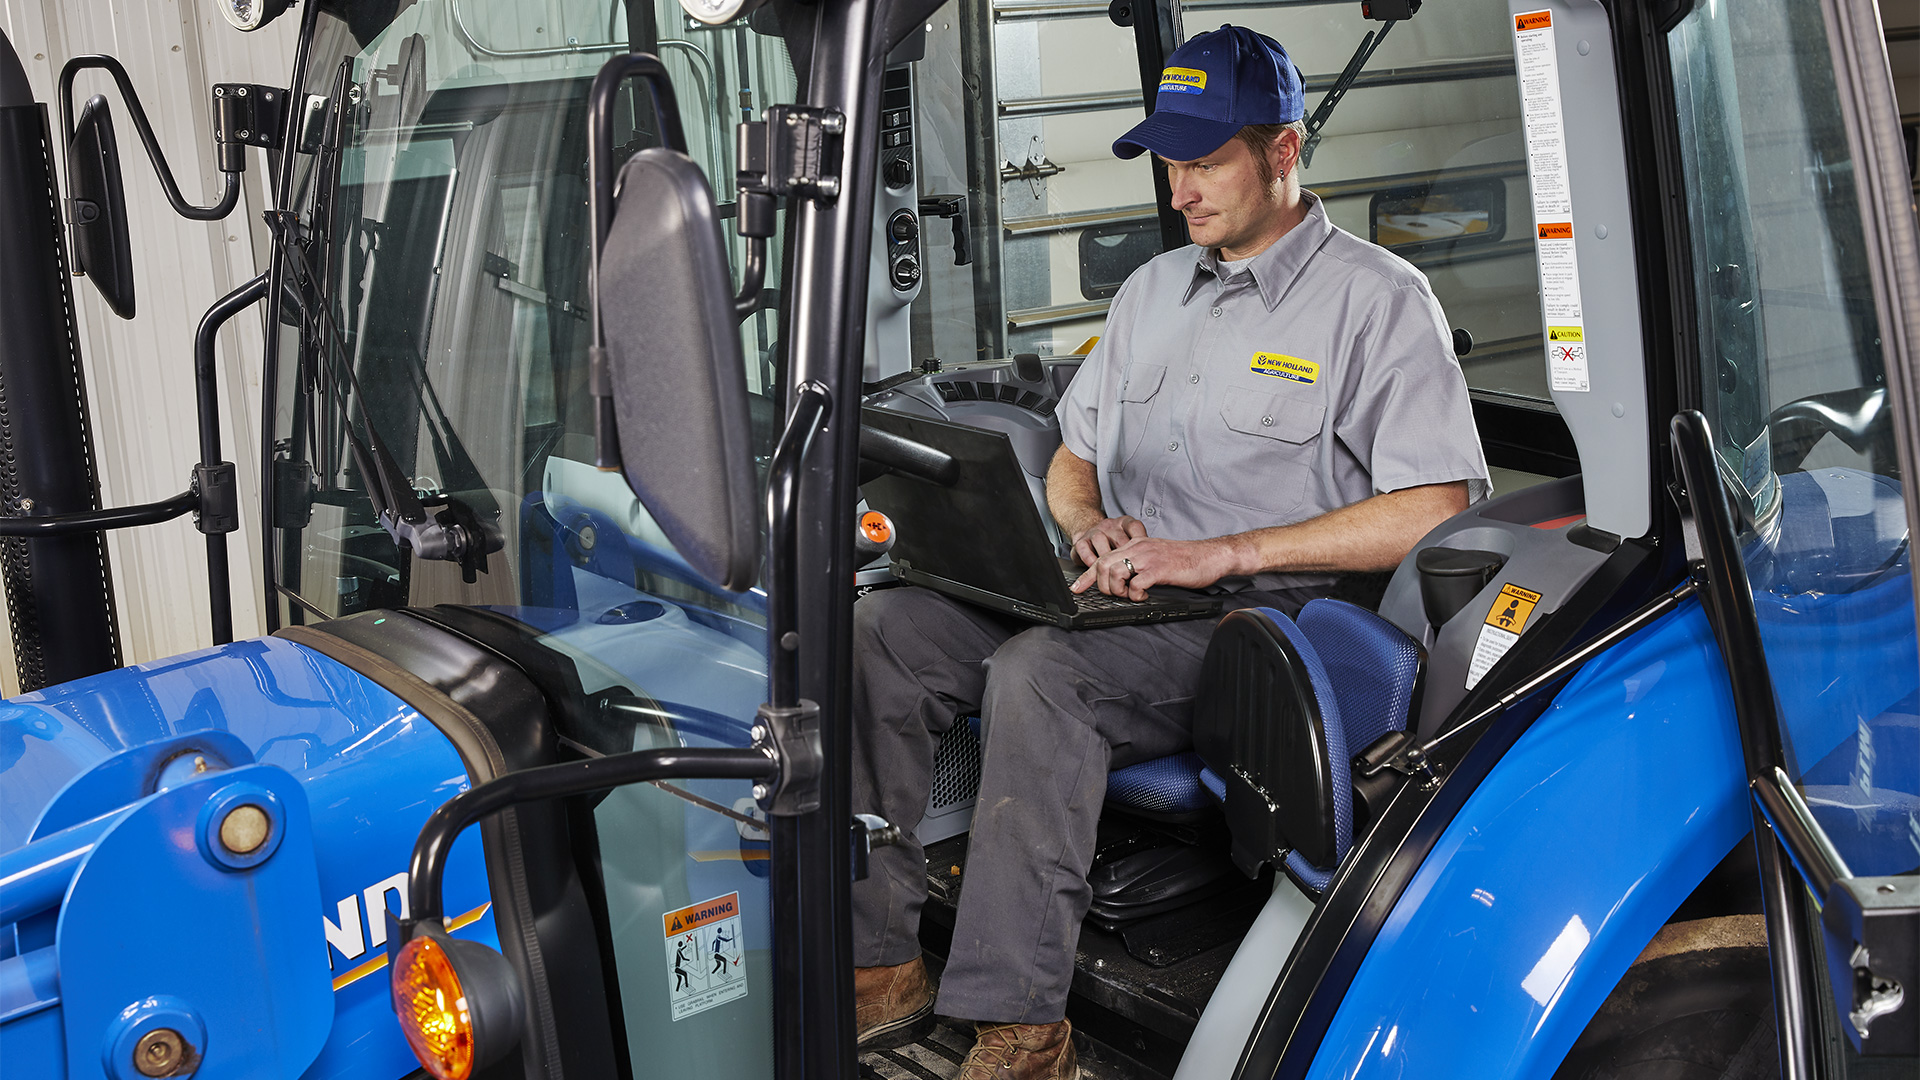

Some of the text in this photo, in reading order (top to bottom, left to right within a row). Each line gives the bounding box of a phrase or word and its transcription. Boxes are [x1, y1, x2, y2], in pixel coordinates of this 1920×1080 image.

[1523, 15, 1550, 25] WARNING
[1171, 74, 1200, 83] HOLLAND
[1282, 362, 1313, 374] HOLLAND
[1263, 369, 1299, 380] AGRICULTURE
[1510, 587, 1537, 601] WARNING
[685, 902, 733, 925] WARNING
